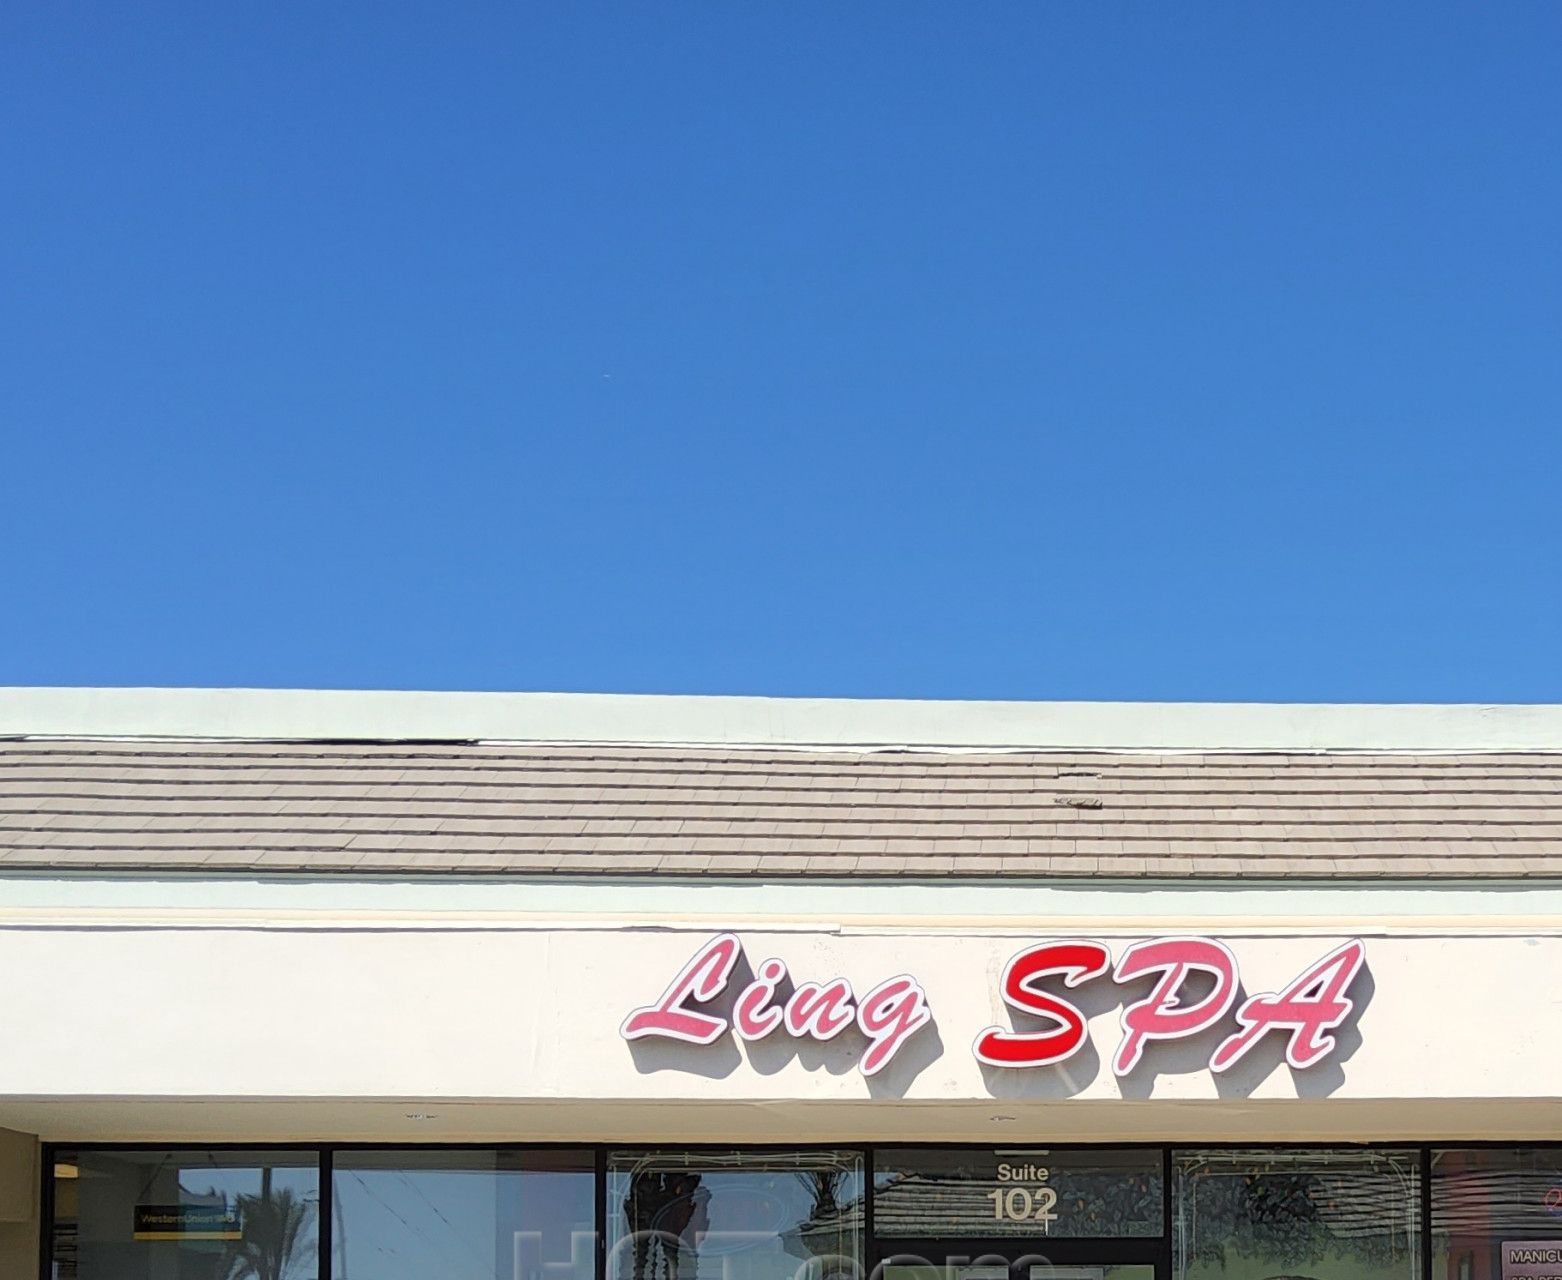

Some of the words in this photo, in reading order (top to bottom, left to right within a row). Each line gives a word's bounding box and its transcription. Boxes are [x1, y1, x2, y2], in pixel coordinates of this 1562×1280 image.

[620, 933, 931, 1076] Ling
[972, 936, 1366, 1077] SPA
[997, 1163, 1049, 1181] Suite
[987, 1187, 1058, 1220] 102
